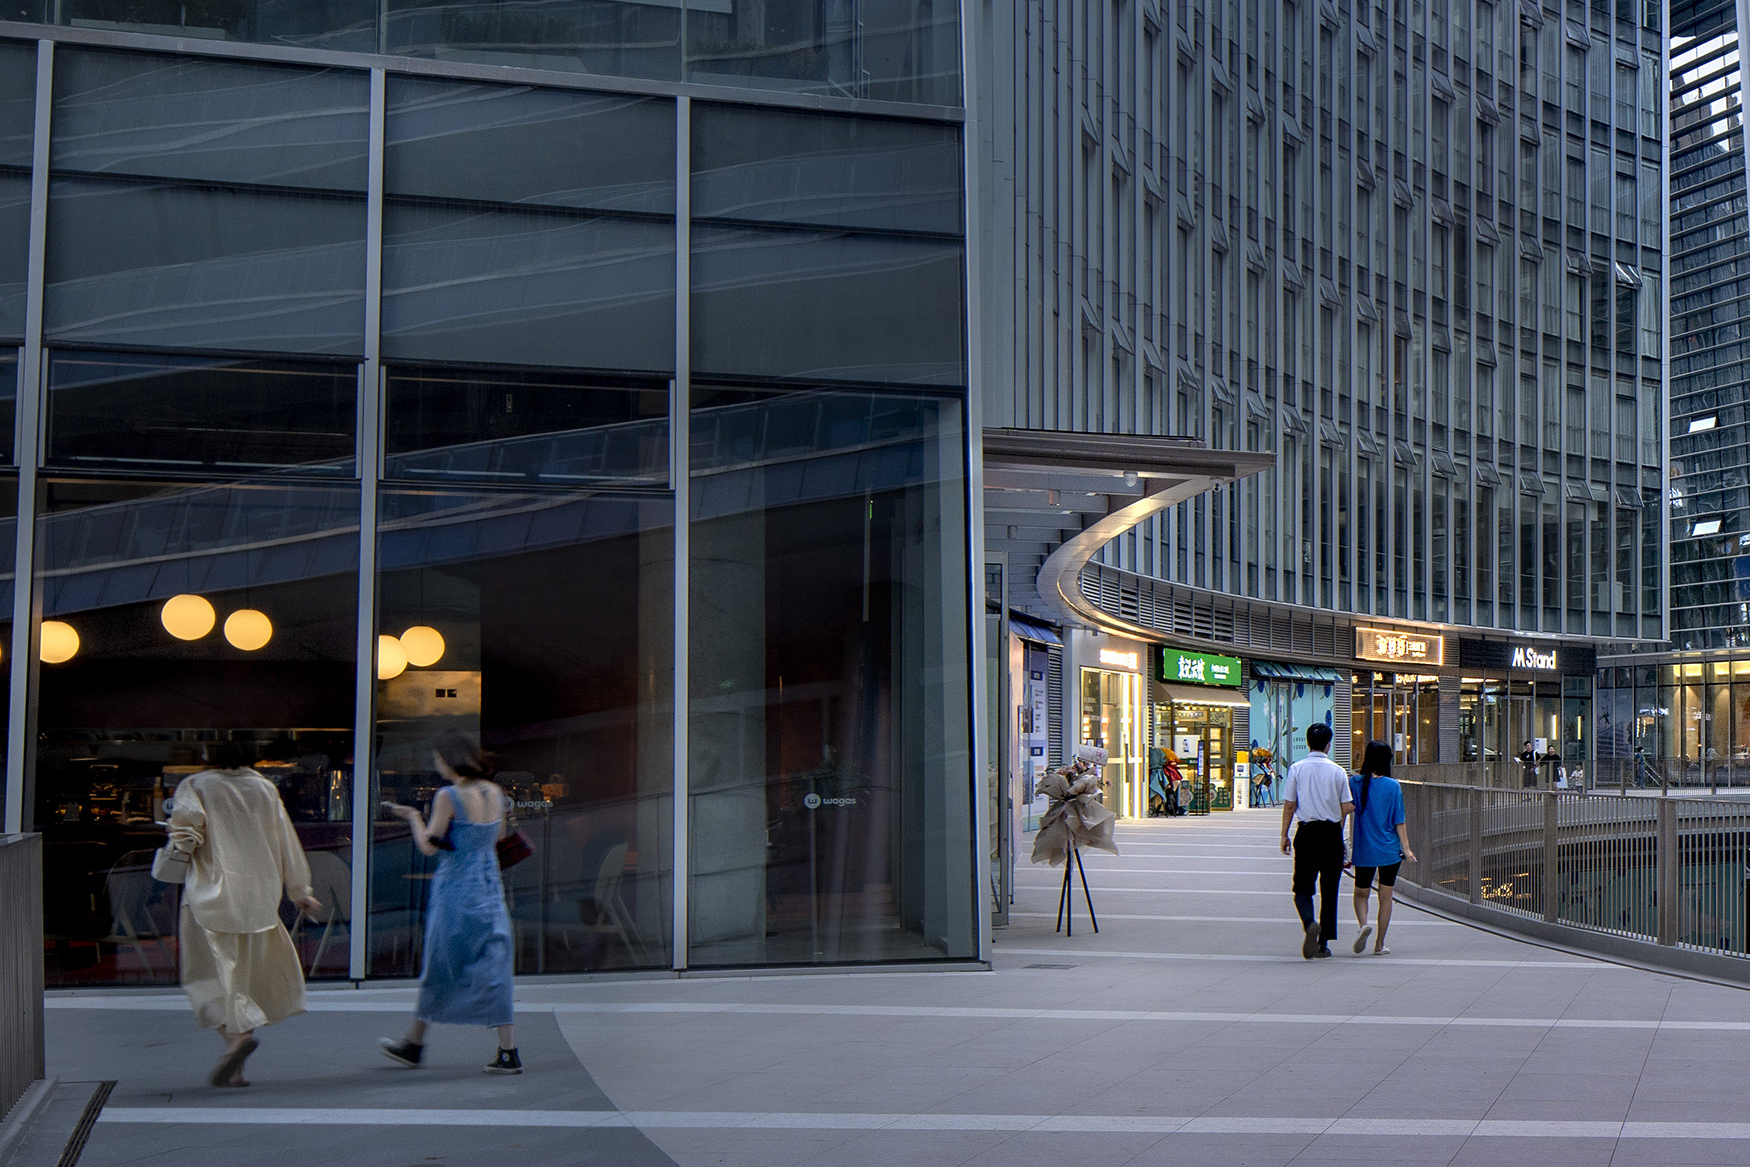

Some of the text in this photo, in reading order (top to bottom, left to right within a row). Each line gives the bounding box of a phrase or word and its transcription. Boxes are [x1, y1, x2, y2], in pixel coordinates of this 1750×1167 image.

[1512, 647, 1556, 670] M Stand
[823, 797, 857, 807] wagas
